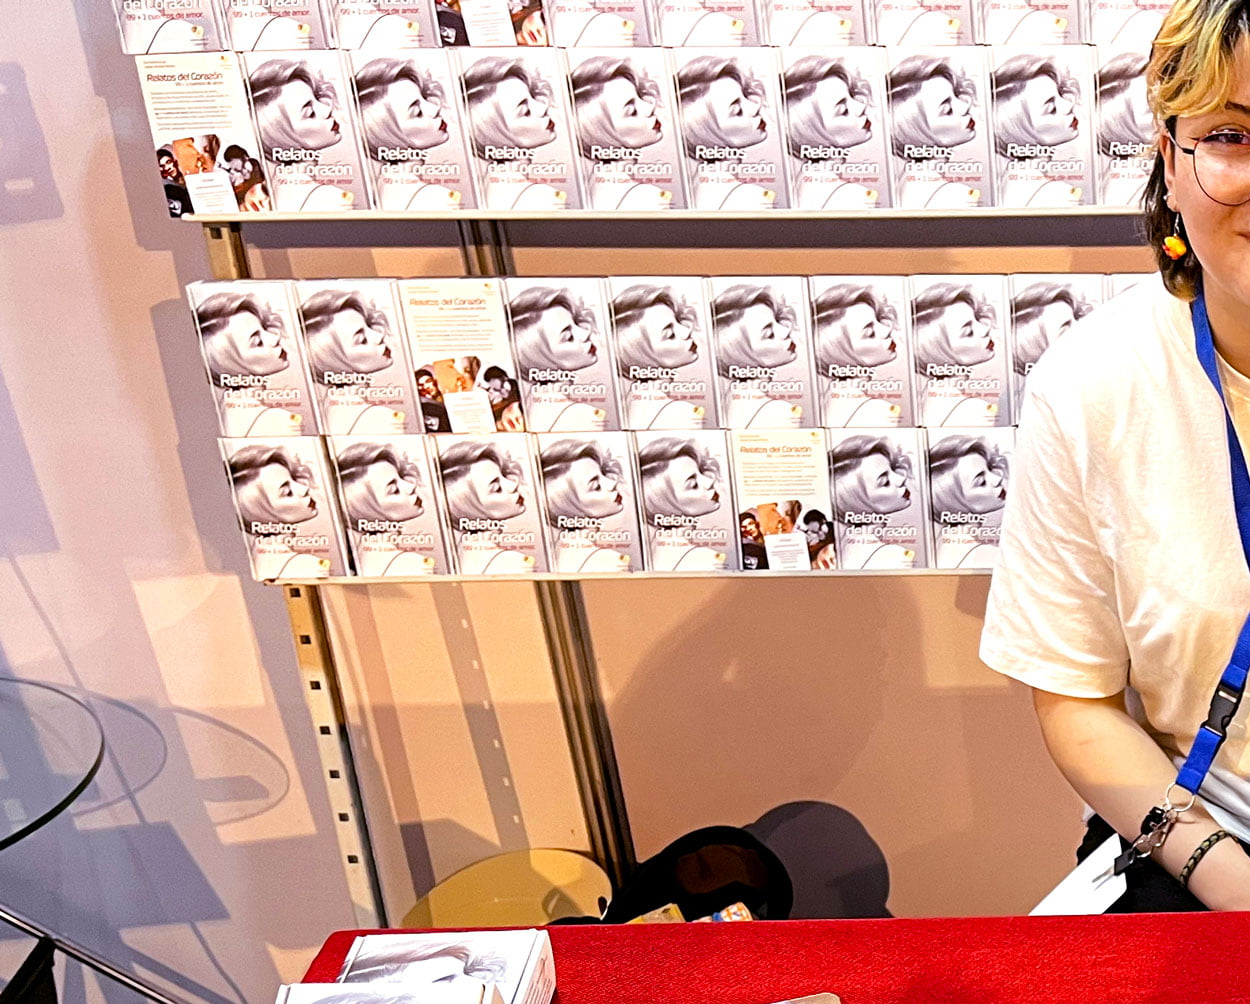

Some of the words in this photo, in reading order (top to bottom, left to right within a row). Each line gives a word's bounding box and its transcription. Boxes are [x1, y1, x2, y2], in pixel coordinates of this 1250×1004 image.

[272, 147, 321, 161] Relatos
[378, 147, 430, 160] Relatos
[485, 146, 536, 159] Relatos
[591, 146, 643, 159] Relatos
[696, 145, 747, 159] Relatos
[800, 145, 850, 159] Relatos
[904, 145, 954, 158] Relatos
[1007, 144, 1057, 157] Relatos
[528, 368, 579, 381] Relatos
[629, 366, 680, 379] Relatos
[728, 365, 779, 378] Relatos
[828, 364, 876, 377] Relatos
[926, 363, 975, 376] Relatos
[220, 374, 272, 387] Relatos
[324, 372, 375, 385] Relatos
[558, 516, 604, 528] Relatos
[654, 514, 700, 526] Relatos
[844, 512, 891, 524] Relatos
[940, 511, 988, 524] Relatos
[251, 521, 300, 534] Relatos
[358, 519, 406, 532] Relatos
[459, 518, 508, 531] Relatos
